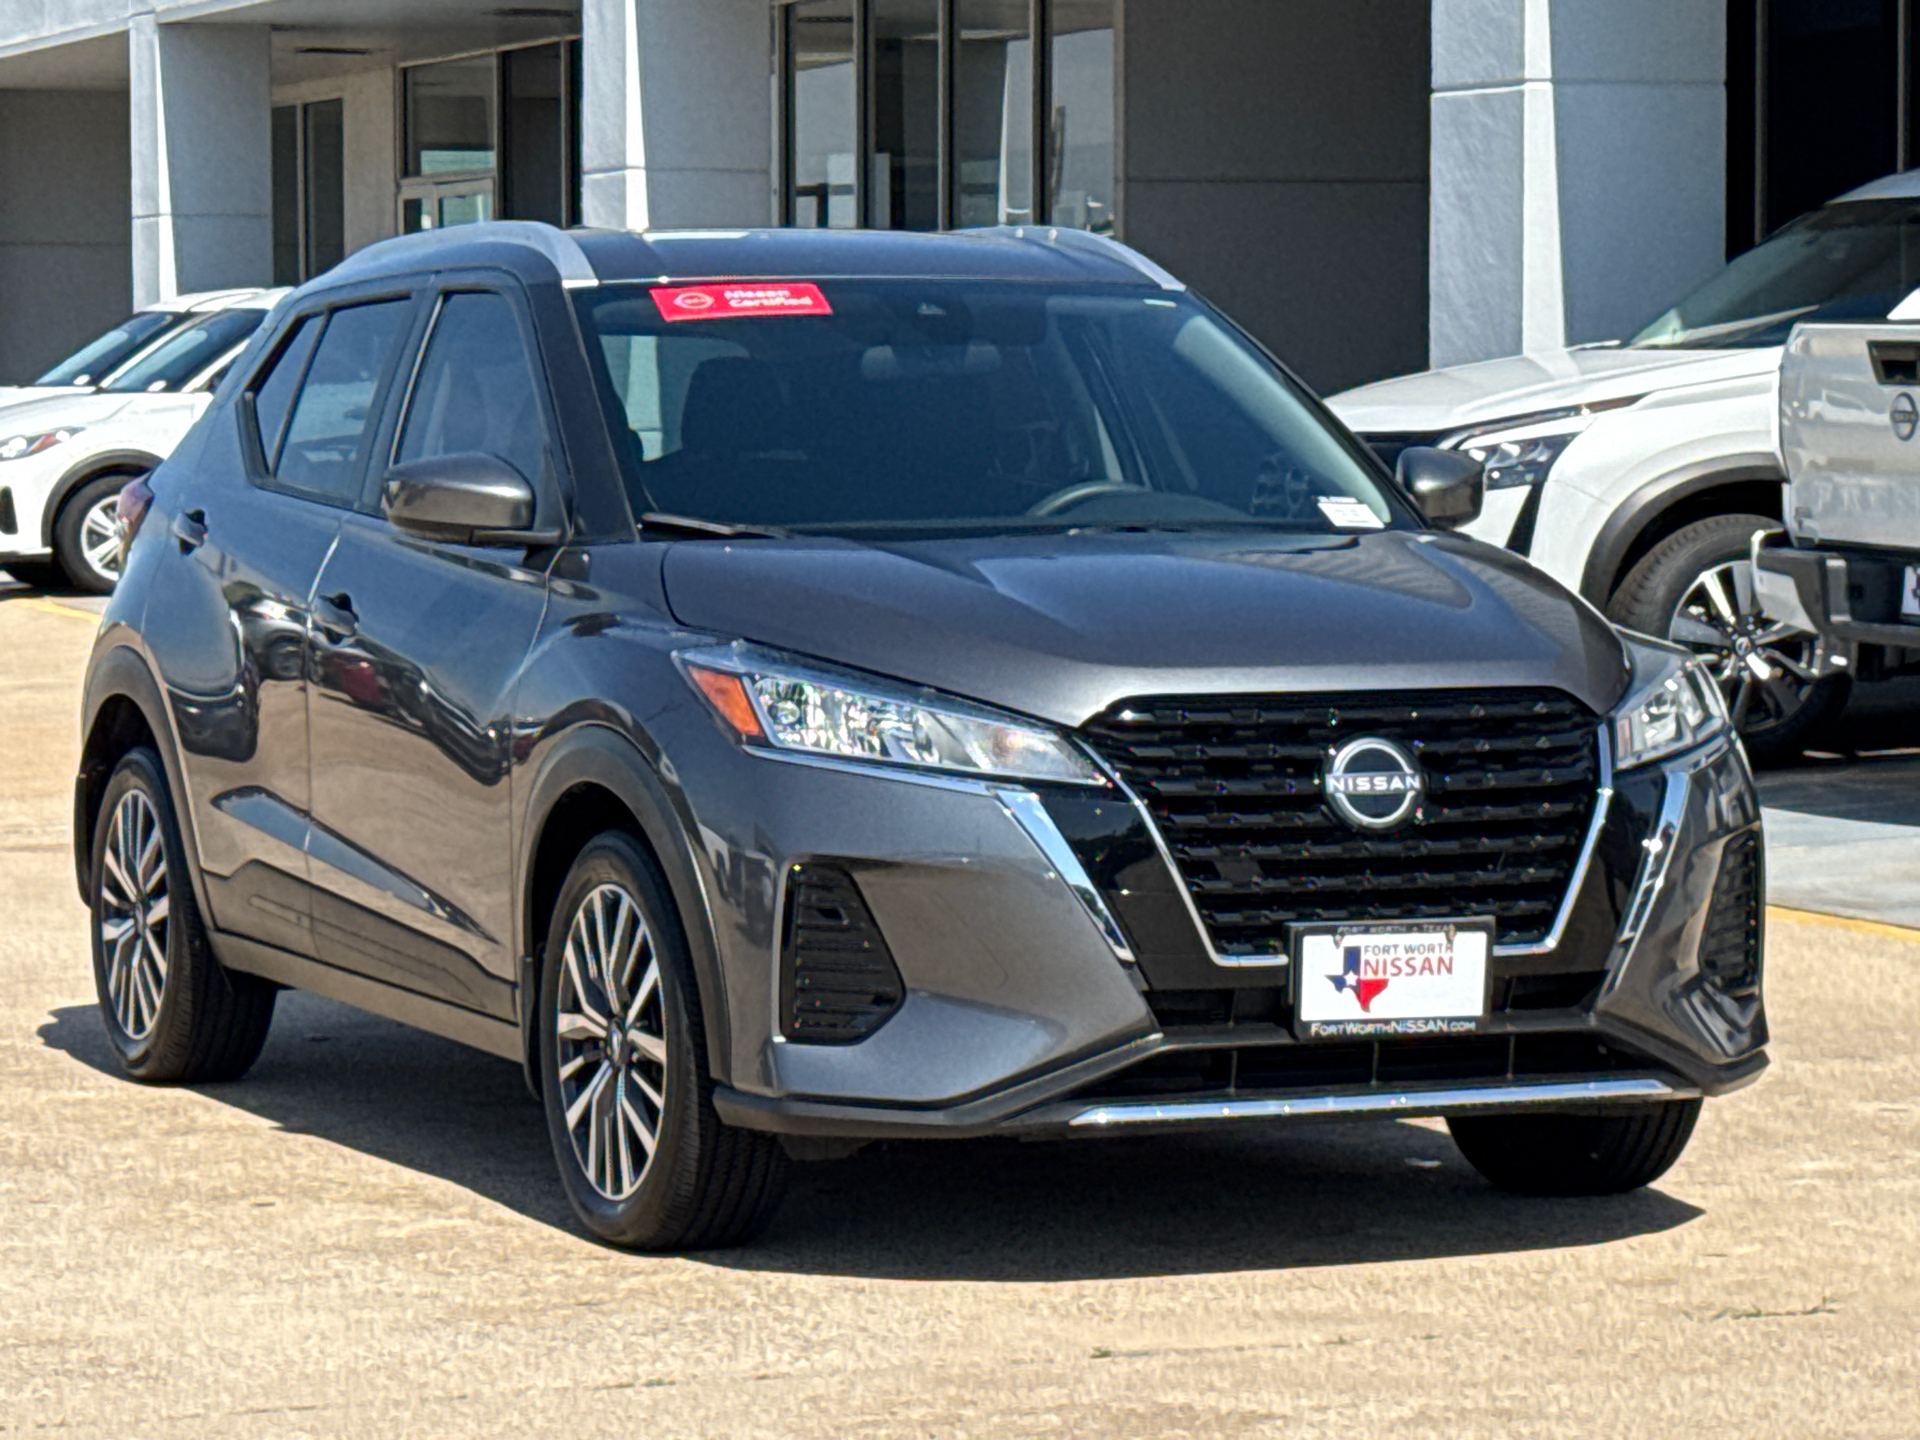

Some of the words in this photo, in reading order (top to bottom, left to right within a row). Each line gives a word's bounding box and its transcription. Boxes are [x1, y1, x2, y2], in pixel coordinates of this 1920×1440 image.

[728, 296, 814, 308] Certified
[1328, 774, 1420, 792] NISSAN
[1364, 944, 1399, 956] FORT
[1404, 943, 1454, 955] WORTH
[1364, 956, 1453, 977] NISSAN
